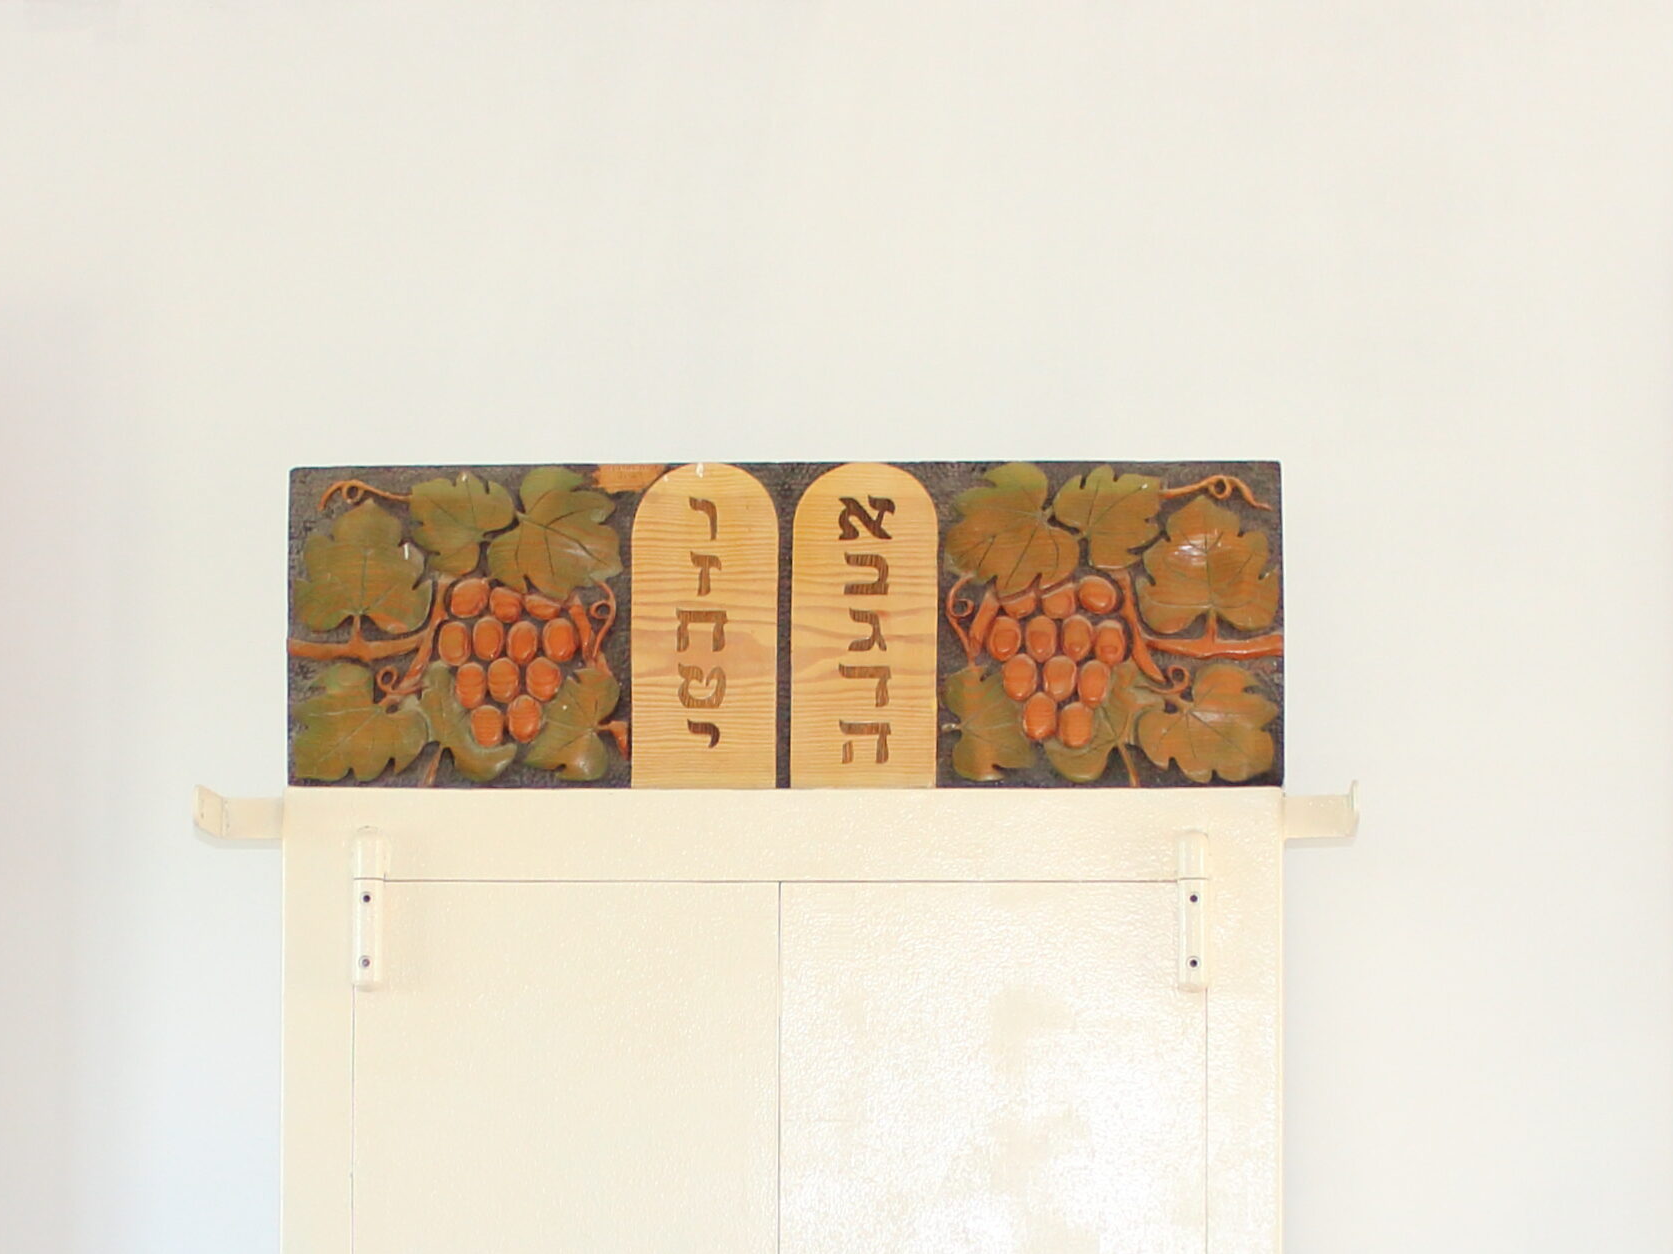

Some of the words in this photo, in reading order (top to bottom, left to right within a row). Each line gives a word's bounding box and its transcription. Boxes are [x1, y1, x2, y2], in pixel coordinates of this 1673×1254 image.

[838, 495, 896, 541] א
[690, 551, 722, 597] ז
[843, 552, 889, 595] ב
[676, 608, 727, 652] ח
[847, 608, 888, 652] ג
[677, 663, 727, 709] ט
[838, 663, 892, 708] ד
[687, 719, 721, 749] י
[839, 719, 892, 764] ה
